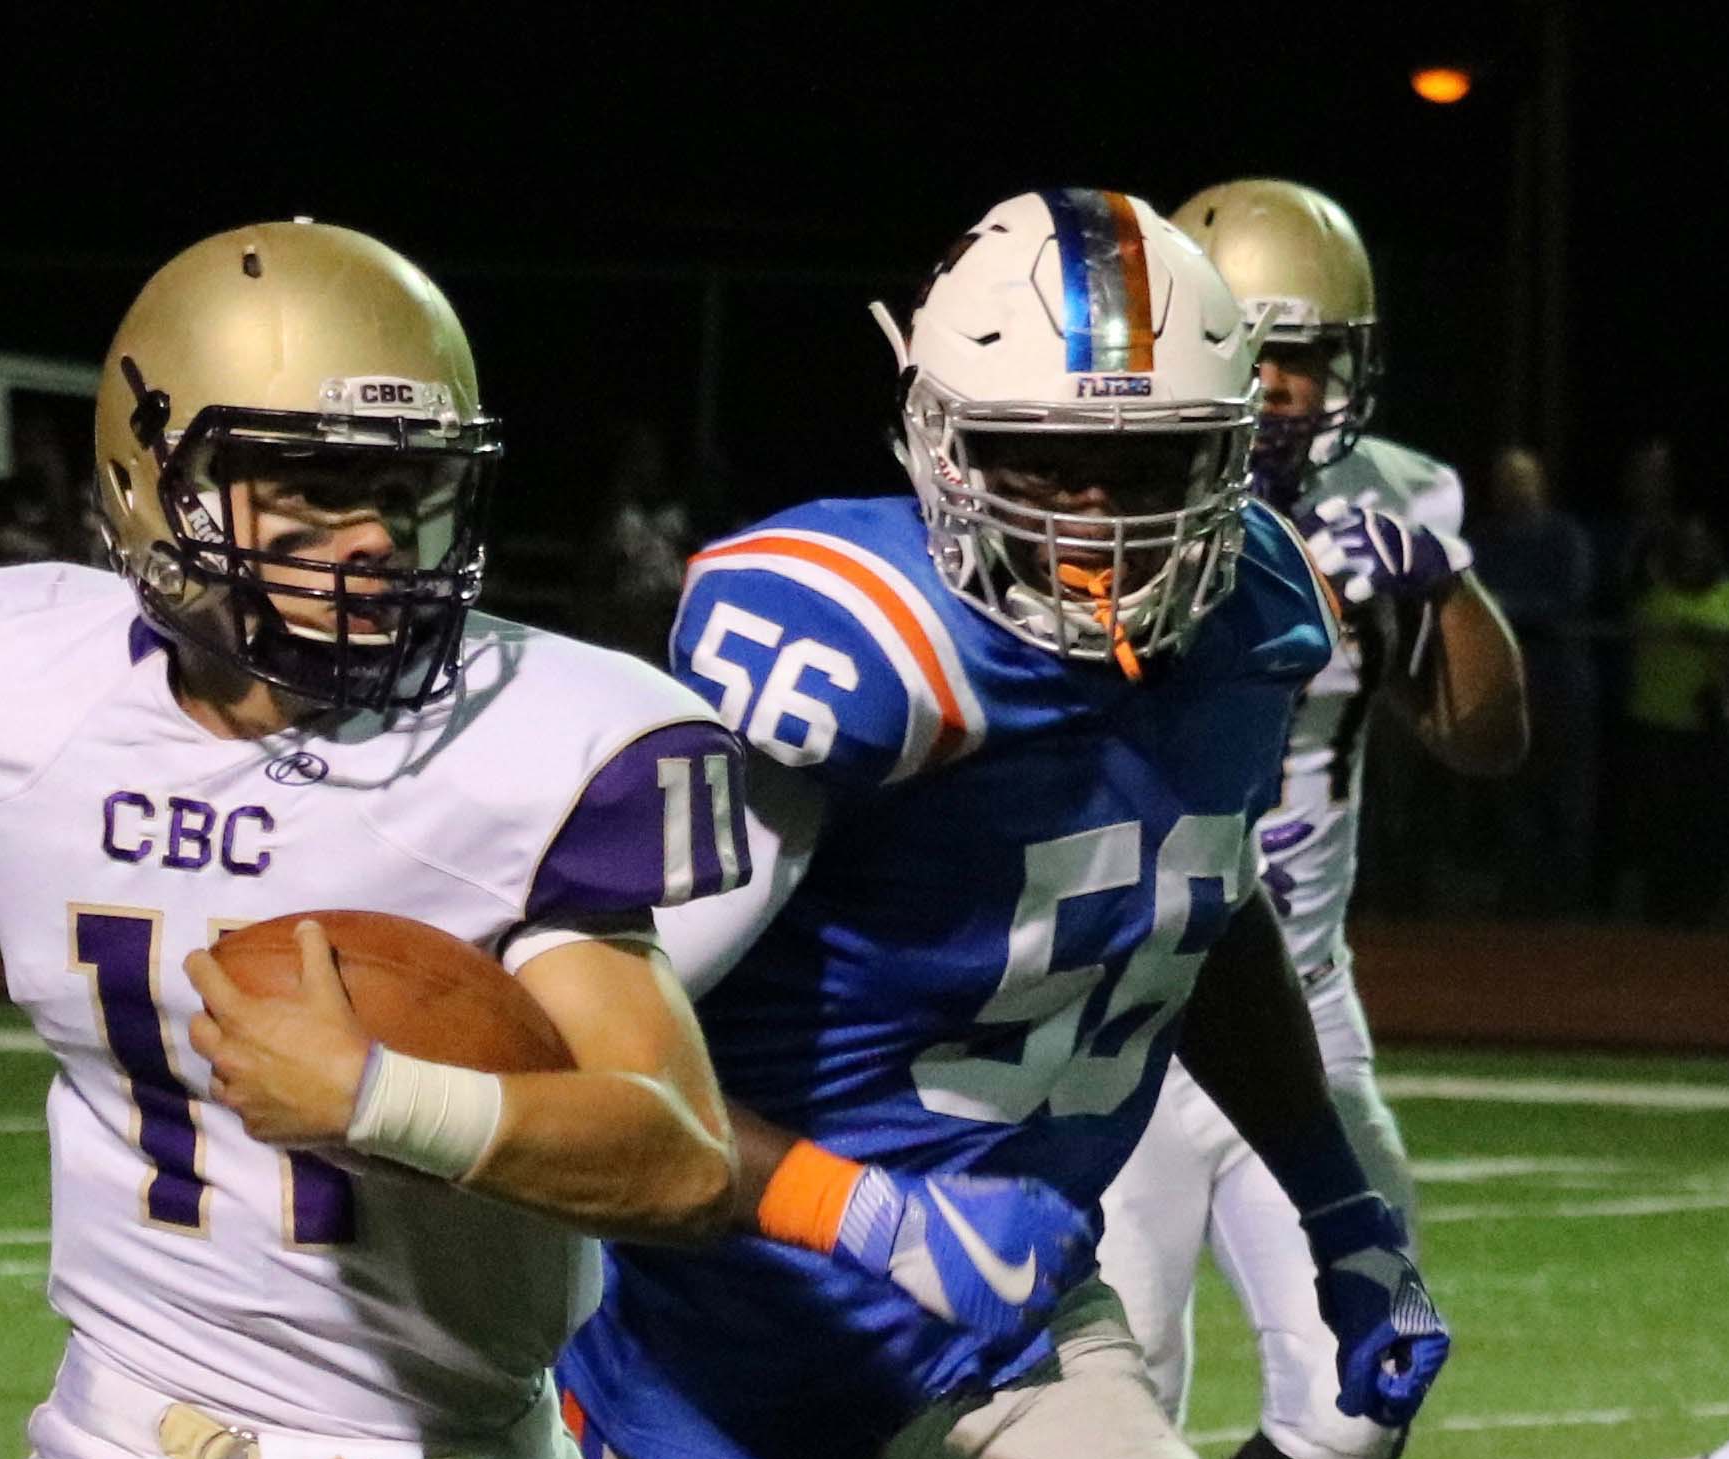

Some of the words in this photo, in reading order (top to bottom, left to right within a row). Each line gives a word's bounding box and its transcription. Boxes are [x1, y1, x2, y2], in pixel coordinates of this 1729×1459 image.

[360, 384, 414, 404] CBC
[689, 600, 860, 768] 56
[100, 789, 274, 877] CBC
[657, 753, 743, 906] 11
[909, 811, 1247, 1126] 56
